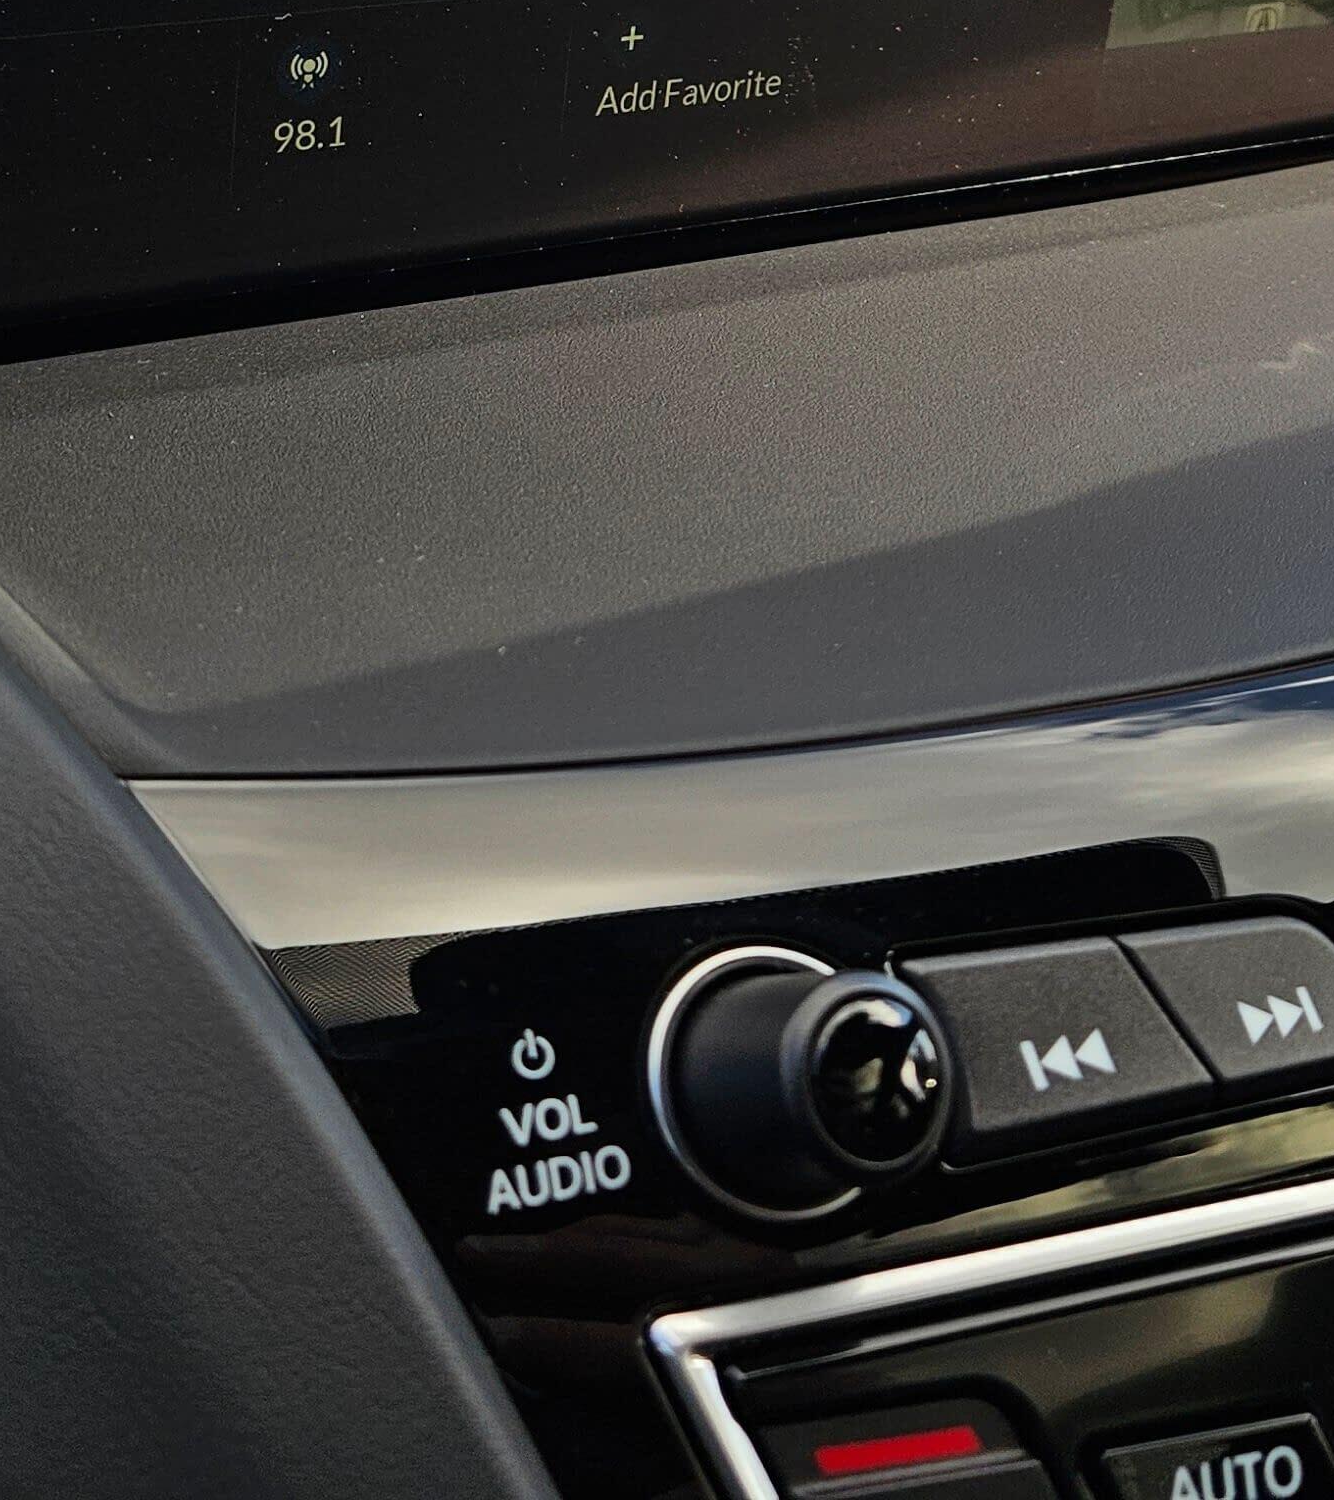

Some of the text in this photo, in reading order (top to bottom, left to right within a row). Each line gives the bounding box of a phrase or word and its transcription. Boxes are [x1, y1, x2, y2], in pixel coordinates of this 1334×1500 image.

[595, 71, 782, 117] Add Favorite
[274, 116, 346, 153] 98.1
[499, 1093, 599, 1147] VOL
[487, 1137, 631, 1215] AUDIO
[1170, 1445, 1303, 1500] AUTO
